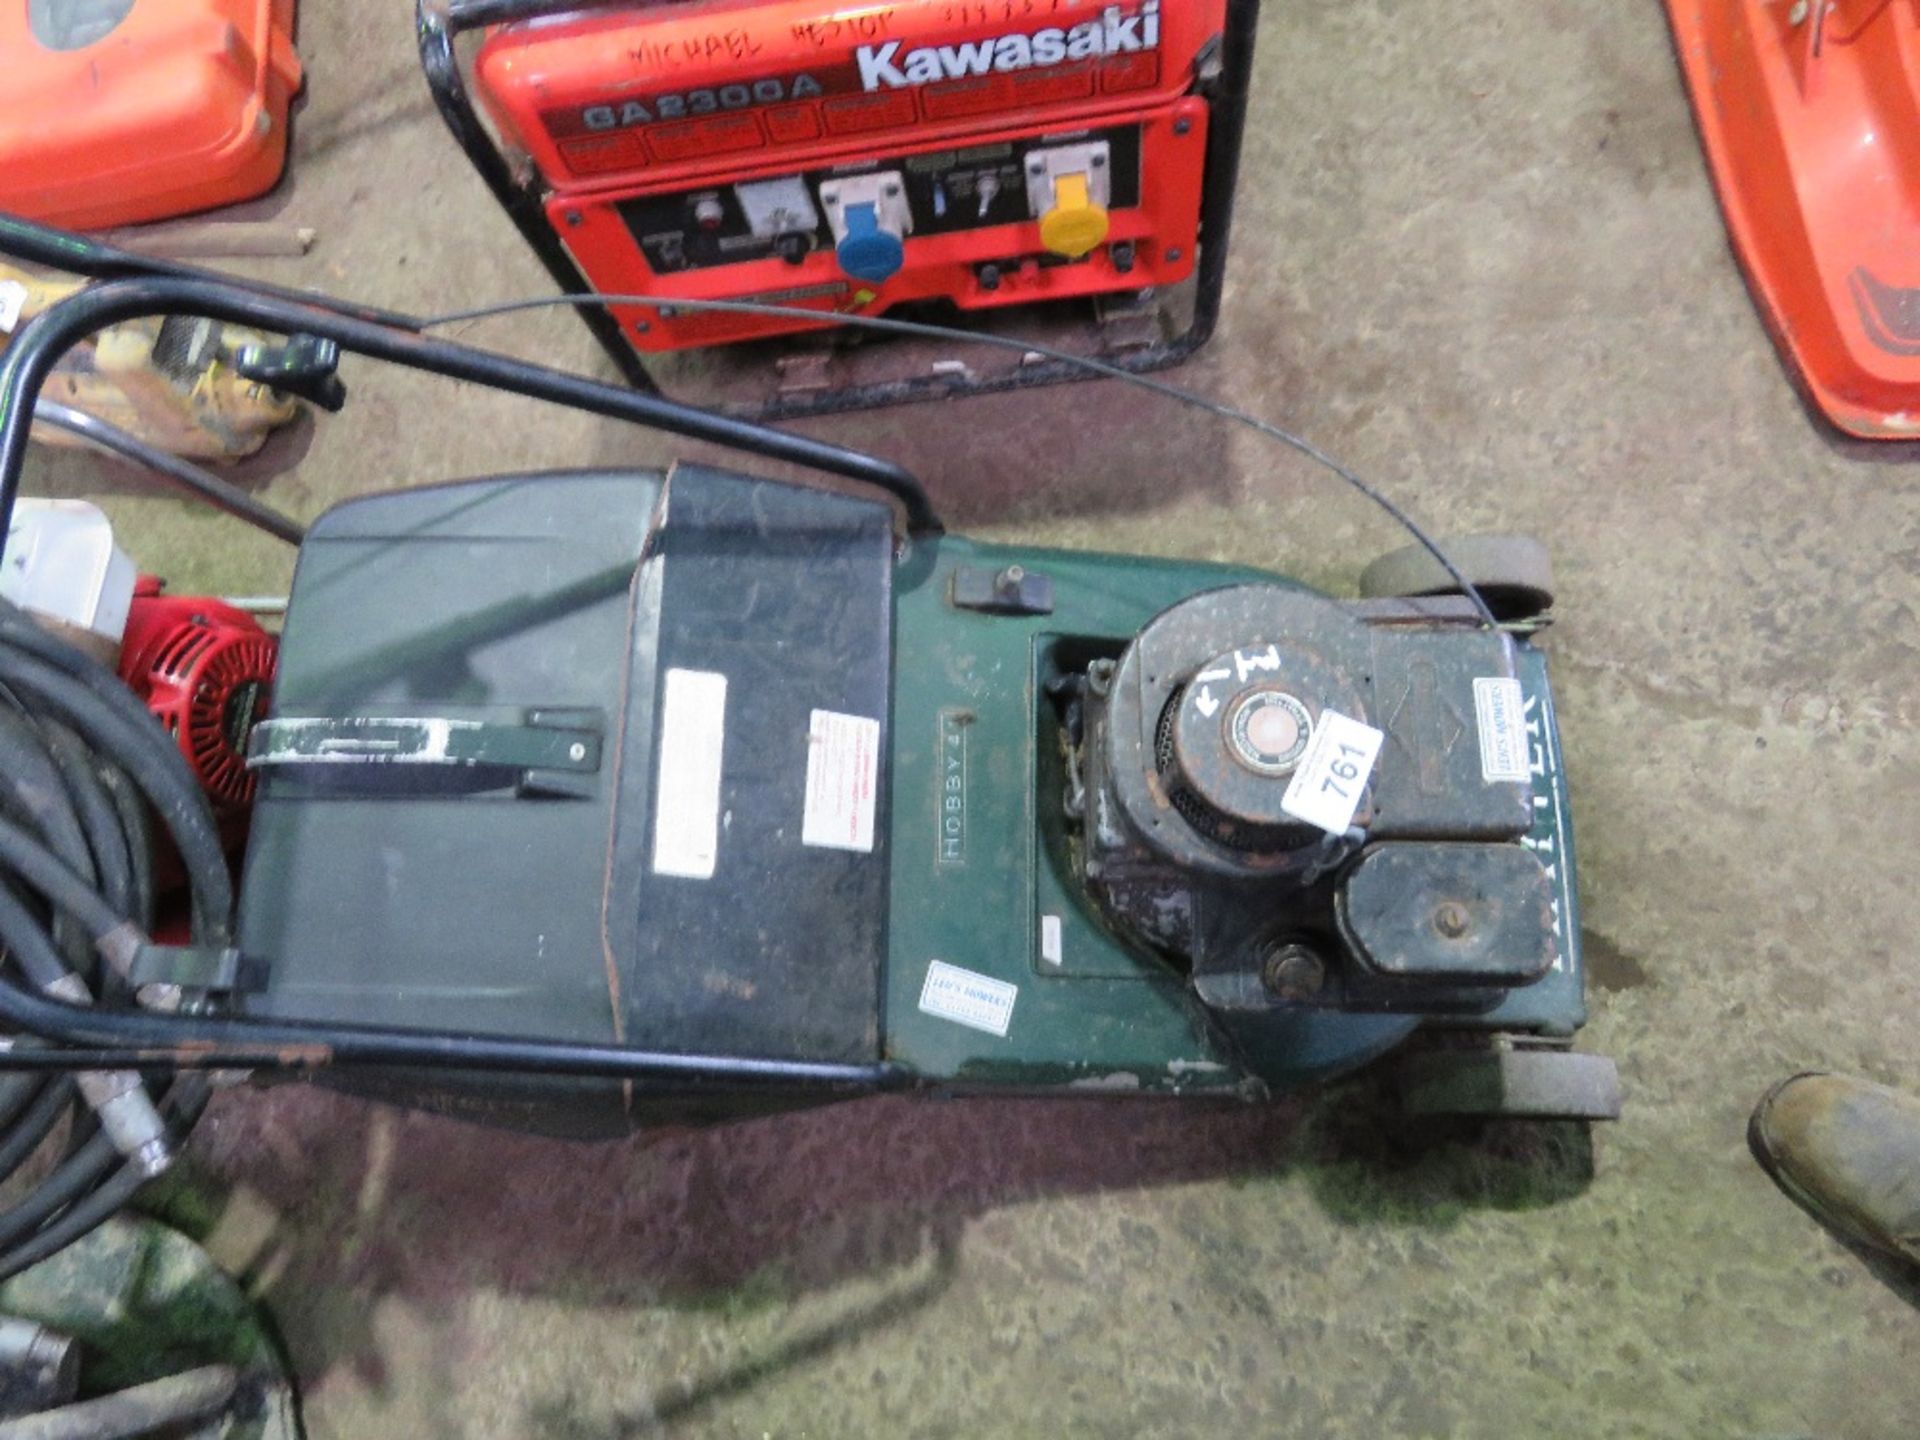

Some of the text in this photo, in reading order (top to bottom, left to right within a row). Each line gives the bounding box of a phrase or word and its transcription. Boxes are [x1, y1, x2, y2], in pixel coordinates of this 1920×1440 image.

[856, 1, 1159, 93] Kawasaki
[583, 73, 823, 130] GA2300A
[944, 755, 961, 858] HOBBY
[1320, 743, 1366, 798] 761
